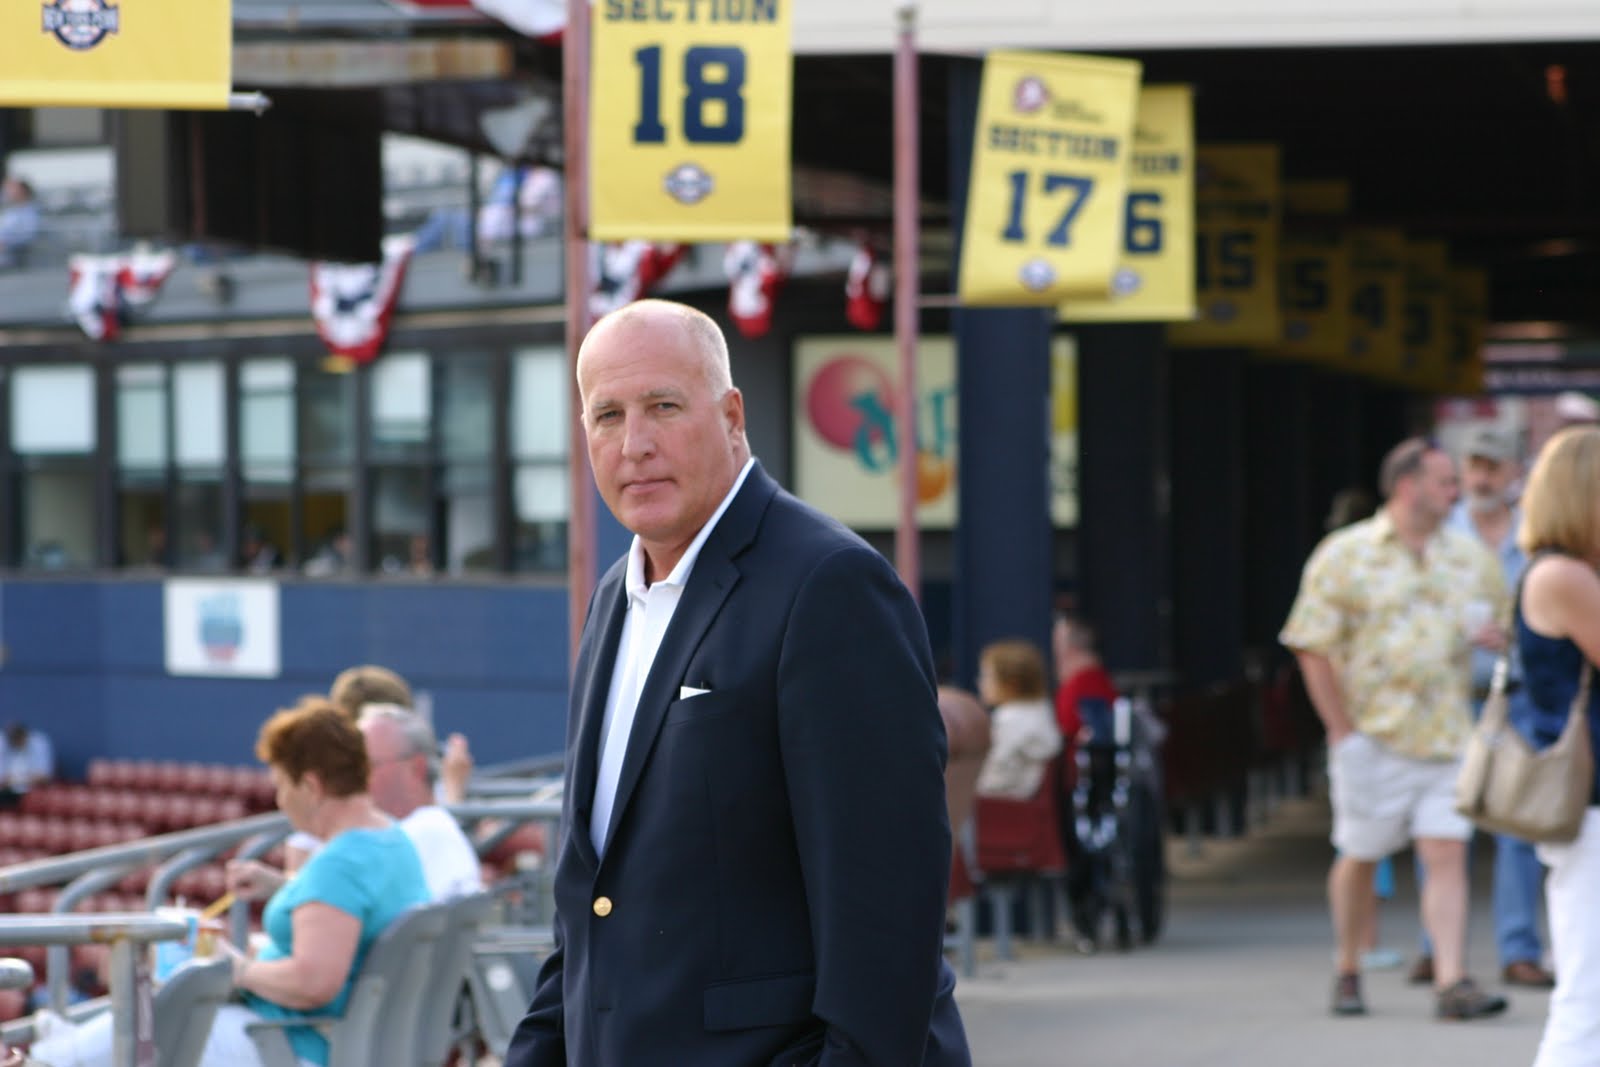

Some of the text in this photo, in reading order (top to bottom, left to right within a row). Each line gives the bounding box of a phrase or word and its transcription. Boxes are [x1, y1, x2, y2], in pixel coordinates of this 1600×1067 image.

[605, 0, 779, 22] SECTION
[633, 45, 746, 145] 18
[988, 124, 1119, 160] SECTION
[1001, 170, 1096, 247] 17
[1124, 190, 1164, 254] 6
